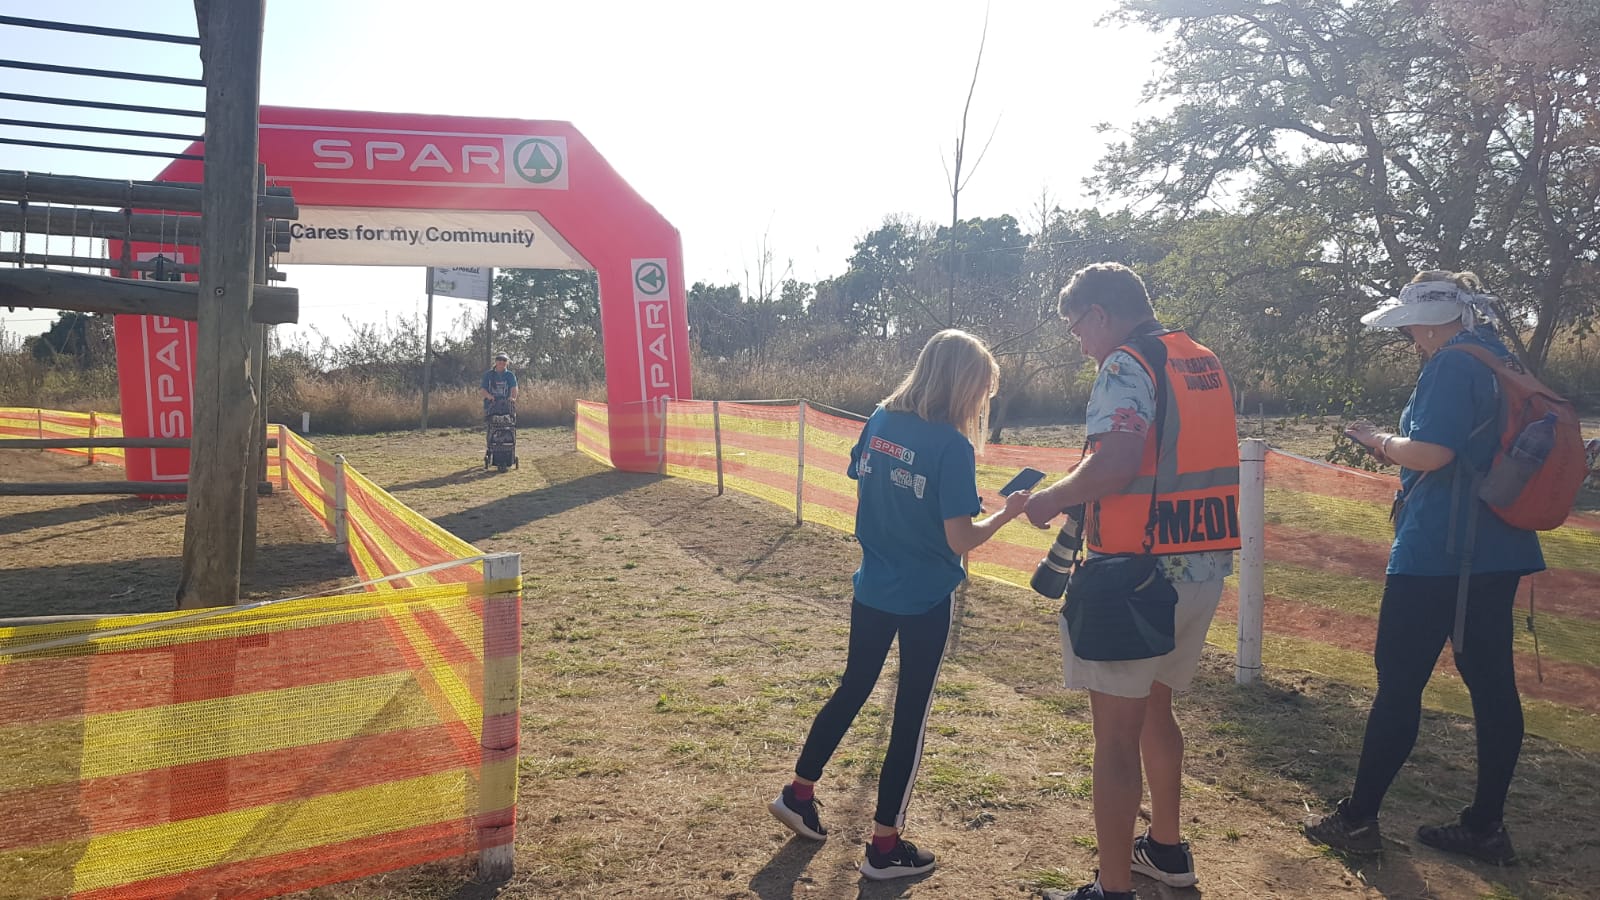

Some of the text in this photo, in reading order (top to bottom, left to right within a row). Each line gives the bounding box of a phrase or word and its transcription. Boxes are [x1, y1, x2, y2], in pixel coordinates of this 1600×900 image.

[313, 139, 499, 174] SPAR
[290, 223, 534, 247] Cares for my Community
[645, 303, 671, 419] SPAR
[874, 439, 903, 459] SPAR
